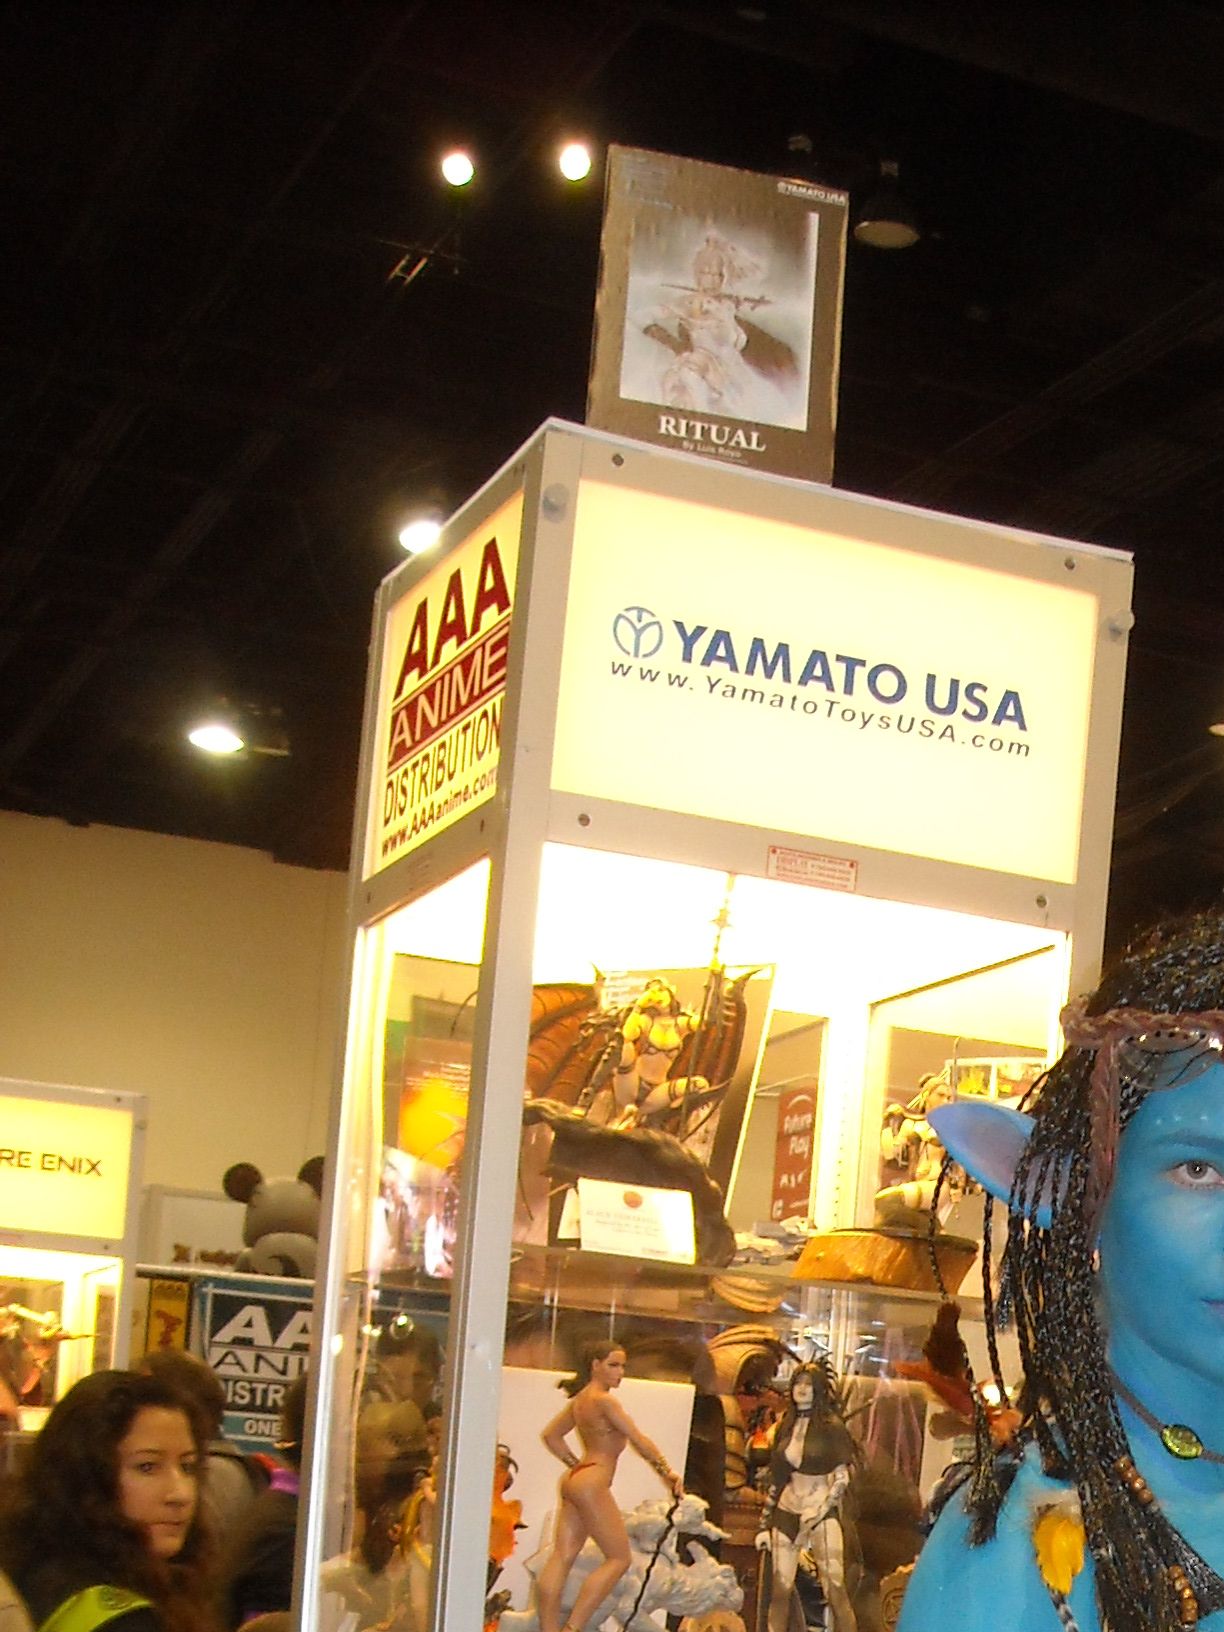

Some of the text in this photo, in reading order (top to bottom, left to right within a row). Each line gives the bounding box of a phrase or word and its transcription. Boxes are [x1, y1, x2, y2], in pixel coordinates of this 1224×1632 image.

[659, 415, 767, 452] RITUAL
[392, 536, 512, 702] AAA
[389, 632, 508, 764] ANIME
[672, 619, 1029, 732] YAMATO USA
[382, 699, 502, 829] DISTRIBUTION
[0, 1148, 102, 1177] RE ENIX
[210, 1304, 313, 1350] AA
[212, 1350, 308, 1377] ANI
[243, 1419, 282, 1437] ONE
